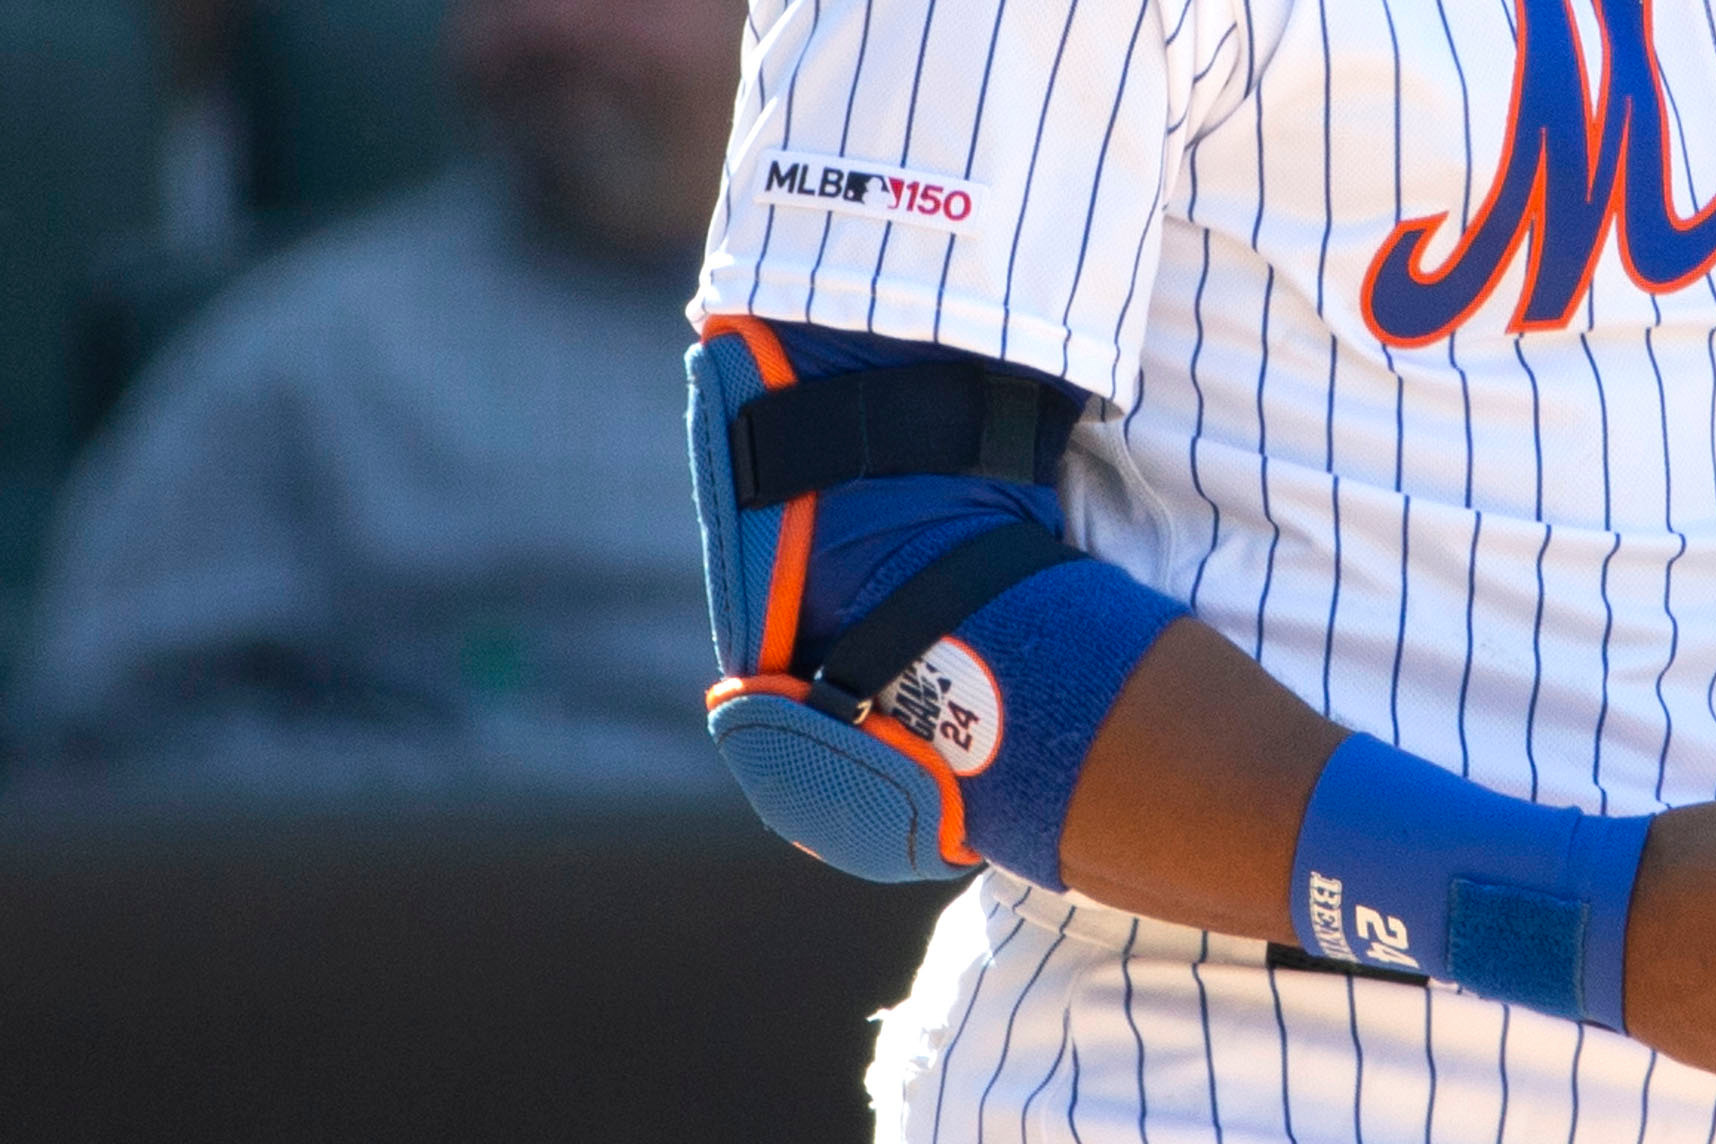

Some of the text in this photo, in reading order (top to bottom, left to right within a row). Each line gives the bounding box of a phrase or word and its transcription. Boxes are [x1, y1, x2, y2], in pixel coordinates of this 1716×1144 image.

[764, 160, 973, 222] MLB 150
[940, 700, 980, 752] 24
[1355, 903, 1421, 969] 24
